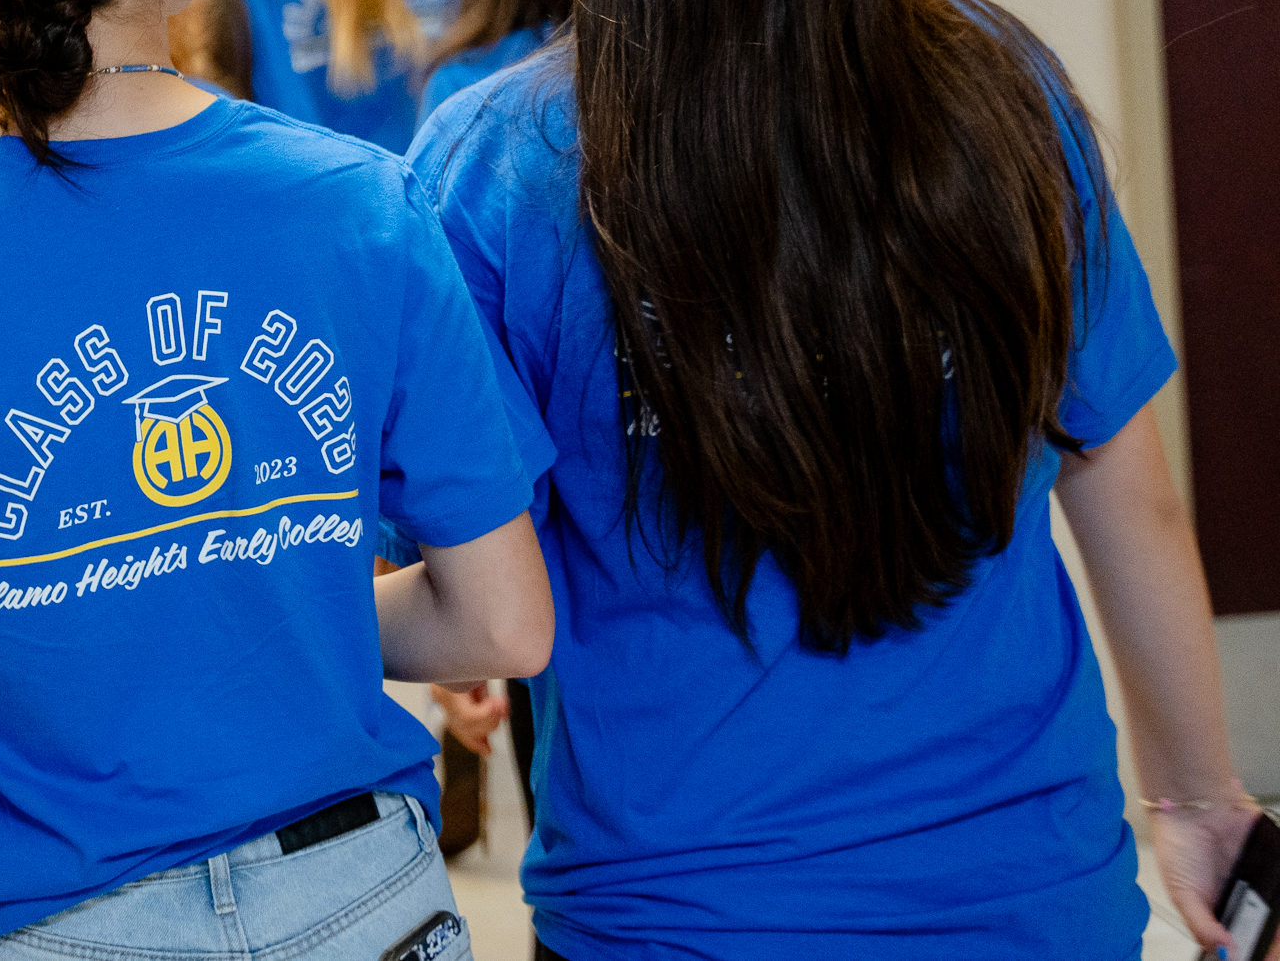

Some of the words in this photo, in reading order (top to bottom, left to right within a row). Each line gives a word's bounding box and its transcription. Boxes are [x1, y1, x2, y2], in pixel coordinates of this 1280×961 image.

[145, 289, 229, 367] OF
[57, 499, 112, 530] EST.
[75, 542, 188, 597] Heights
[197, 527, 278, 565] Early
[278, 513, 364, 550] Colleg
